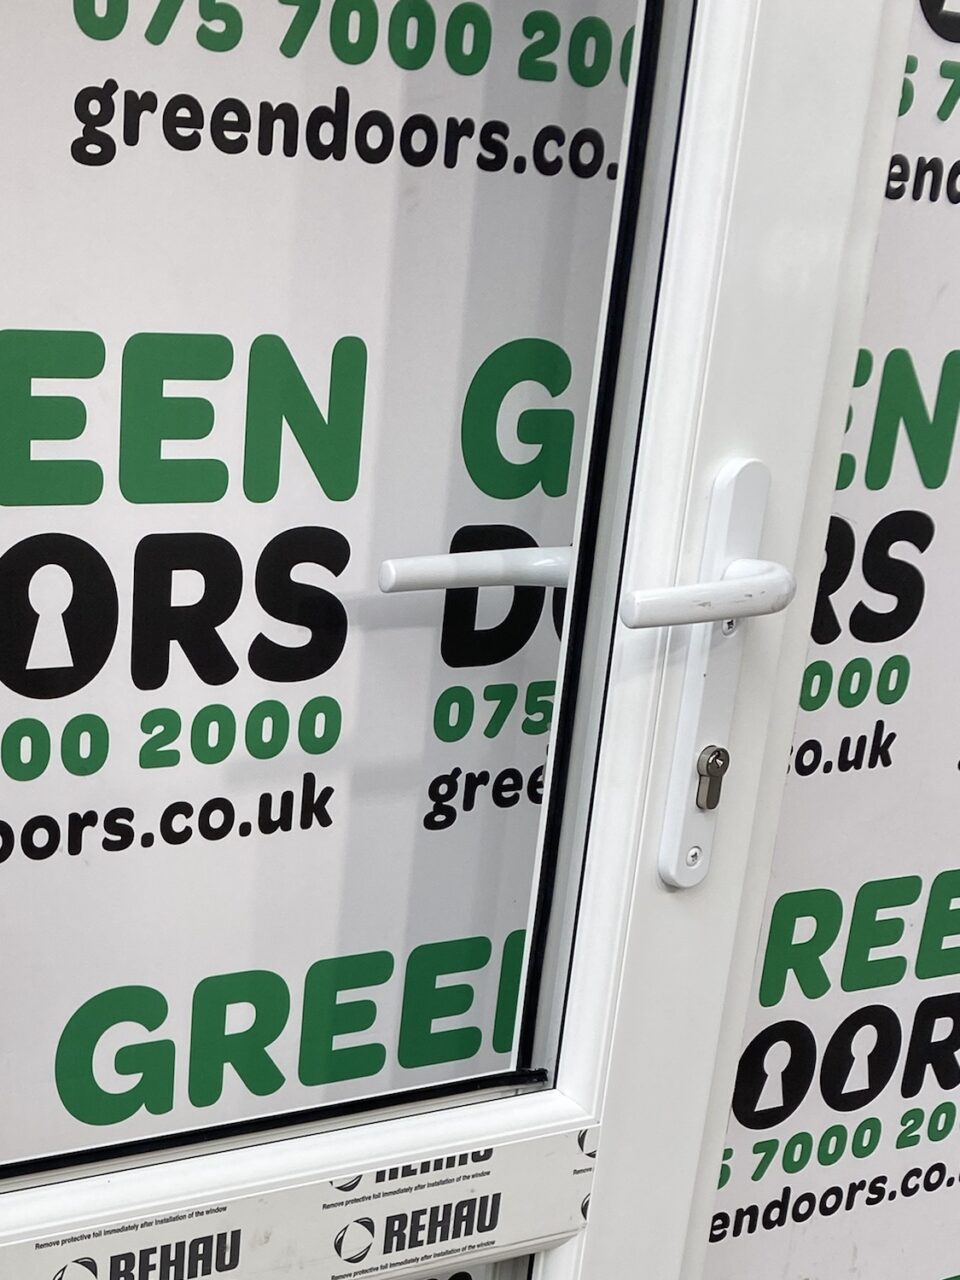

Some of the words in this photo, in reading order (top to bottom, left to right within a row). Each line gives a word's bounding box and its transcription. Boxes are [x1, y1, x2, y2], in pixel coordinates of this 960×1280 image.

[280, 0, 493, 76] 7000
[70, 78, 619, 181] greendoors.co.
[460, 336, 576, 500] G
[440, 523, 569, 669] D
[433, 679, 557, 743] 075
[799, 654, 911, 712] 000
[138, 695, 343, 769] 2000
[787, 719, 897, 777] o.uk
[751, 1116, 882, 1181] 7000
[895, 1100, 957, 1149] 20
[322, 1202, 345, 1210] Remove
[345, 1194, 372, 1207] protective
[382, 1186, 413, 1198] immediately
[414, 1183, 426, 1191] after
[427, 1177, 455, 1188] installation
[456, 1175, 462, 1183] of
[471, 1170, 490, 1179] window
[35, 1240, 60, 1250] Remove
[61, 1233, 91, 1247] protective
[103, 1223, 139, 1237] immediately
[140, 1220, 153, 1229] after
[155, 1213, 187, 1226] installation
[188, 1211, 194, 1219] of
[195, 1209, 204, 1217] the
[205, 1206, 227, 1216] window
[382, 1192, 502, 1255] REHAU
[331, 1272, 353, 1280] Remove
[353, 1265, 379, 1278] protective
[420, 1253, 432, 1262] after
[462, 1245, 467, 1253] of
[477, 1240, 495, 1249] window
